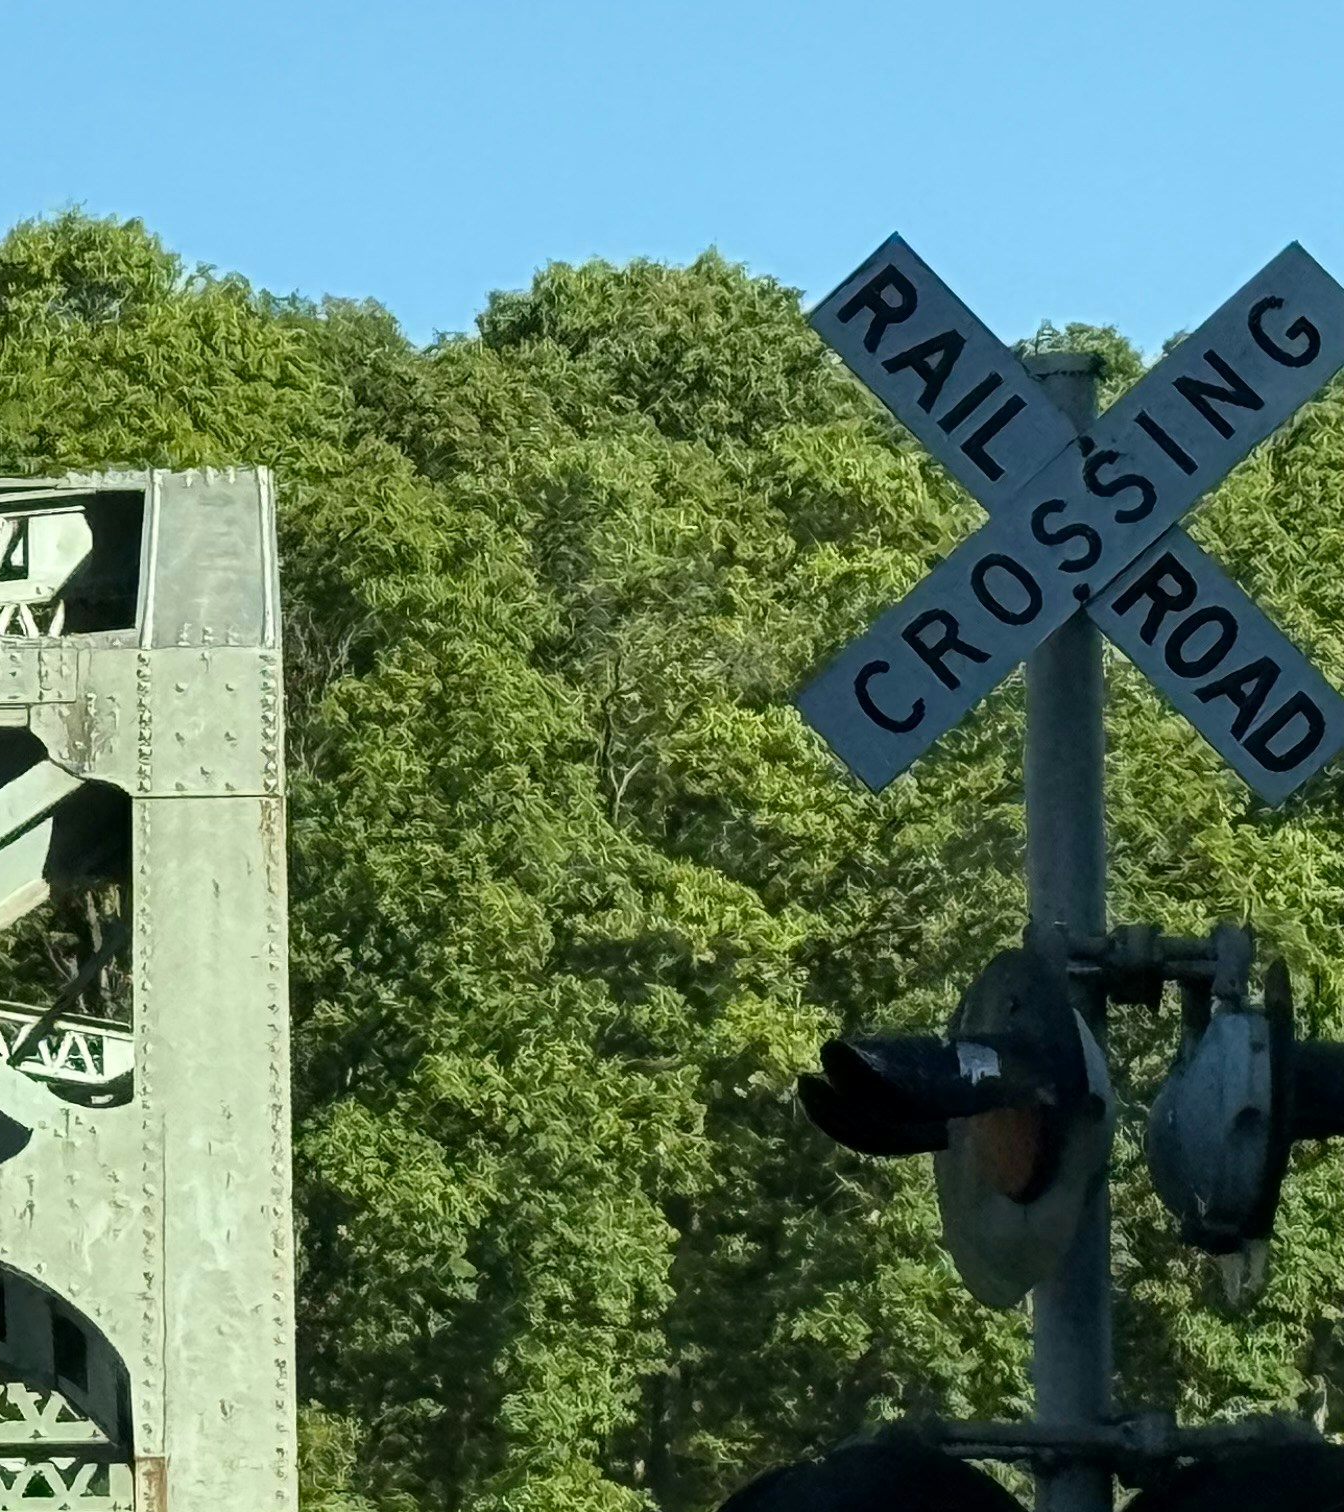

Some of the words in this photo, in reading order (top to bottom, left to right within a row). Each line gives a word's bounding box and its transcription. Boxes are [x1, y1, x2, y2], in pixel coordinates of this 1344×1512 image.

[837, 264, 1028, 482] RAIL
[1111, 552, 1327, 773] ROAD
[853, 295, 1322, 734] CROSSING
